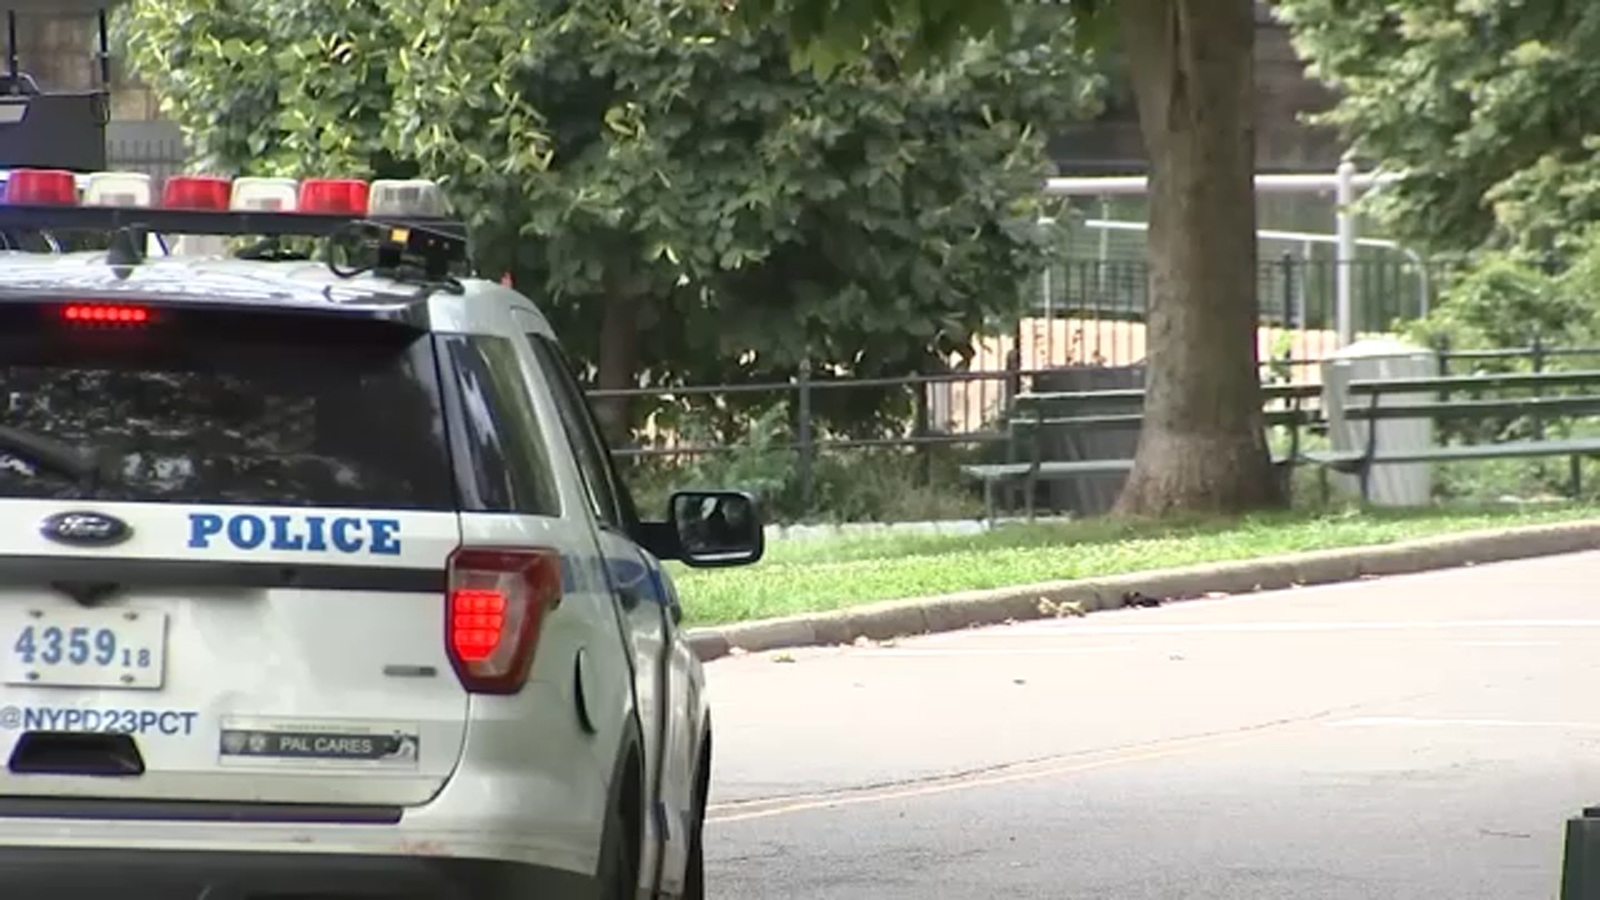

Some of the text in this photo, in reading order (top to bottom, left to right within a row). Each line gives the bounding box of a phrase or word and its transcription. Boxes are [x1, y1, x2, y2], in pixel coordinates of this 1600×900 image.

[188, 513, 401, 555] POLICE
[14, 625, 151, 668] 4359 18
[0, 706, 199, 736] @NYPD23PCT
[279, 736, 373, 754] PAL CARES
